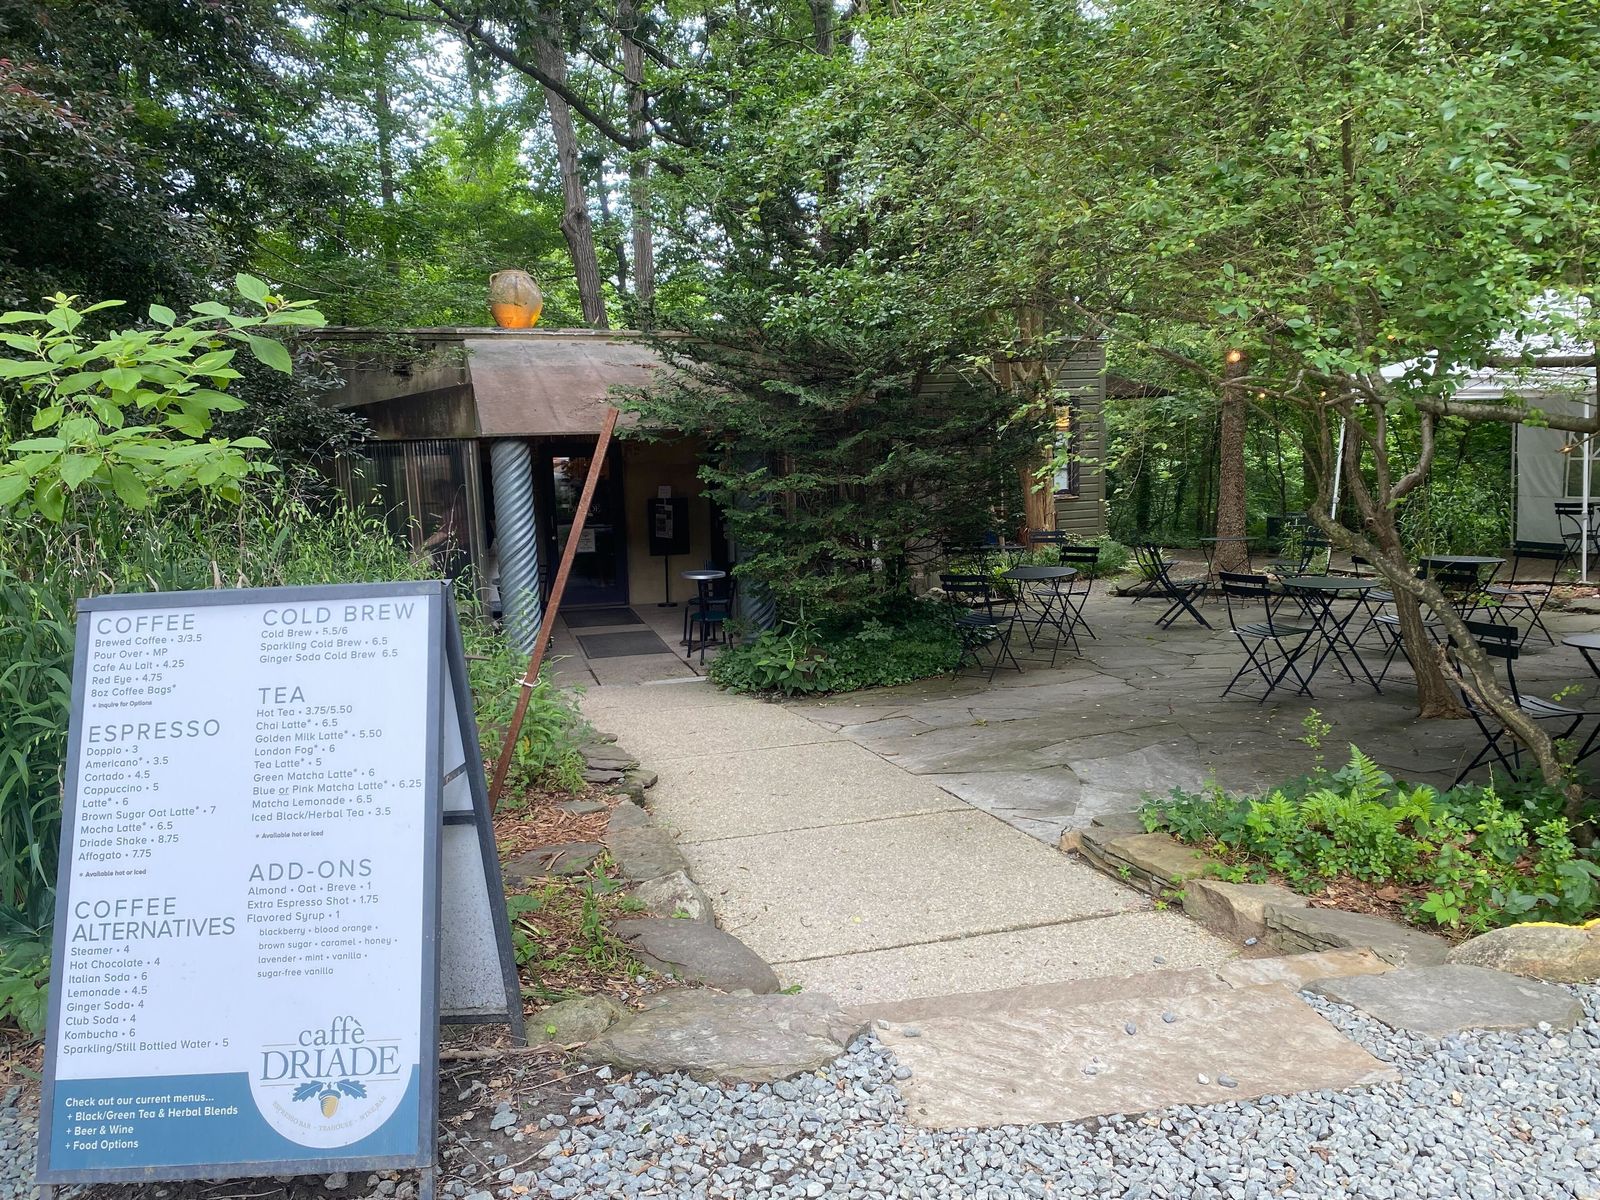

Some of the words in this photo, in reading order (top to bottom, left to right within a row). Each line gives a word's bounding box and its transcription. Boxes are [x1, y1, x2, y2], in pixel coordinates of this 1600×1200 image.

[262, 606, 331, 626] COLD
[344, 602, 414, 622] BREW
[97, 613, 195, 634] COFFEE
[261, 629, 284, 638] Cold
[287, 628, 312, 637] Brew
[322, 626, 348, 635] 5.5/6
[94, 637, 131, 647] Brewed
[134, 636, 166, 645] Coffee
[177, 633, 202, 642] 3/3.5
[260, 641, 307, 652] Sparkling
[310, 639, 333, 648] Cold
[336, 638, 361, 647] Brew
[371, 636, 387, 645] 6.5
[93, 651, 116, 659] Pour
[119, 650, 142, 658] Over
[153, 647, 168, 656] MP
[259, 655, 292, 664] Ginger
[295, 653, 320, 661] Soda
[324, 651, 347, 660] Cold
[350, 650, 375, 658] Brew
[382, 648, 398, 657] 6.5
[92, 663, 115, 672] Cafe
[118, 662, 131, 670] Au
[134, 661, 152, 670] Lait
[162, 659, 184, 668] 4.25
[91, 675, 110, 684] Red
[113, 675, 132, 685] Eye
[142, 672, 162, 682] 4.75
[90, 688, 108, 697] 8oz
[111, 686, 144, 696] Coffee
[258, 685, 305, 704] TEA
[256, 709, 274, 717] Hot
[277, 707, 294, 716] Tea
[305, 704, 352, 715] 3.75/5.50
[255, 721, 278, 730] Chai
[321, 718, 337, 727] 6.5
[88, 719, 220, 743] ESPRESSO
[255, 734, 291, 743] Golden
[294, 732, 315, 741] Milk
[359, 728, 382, 738] 5.50
[254, 746, 291, 756] London
[153, 756, 168, 765] 3.5
[253, 760, 271, 769] Tea
[84, 771, 124, 782] Cortado
[134, 769, 150, 779] 4.5
[253, 773, 283, 782] Green
[287, 771, 324, 780] Matcha
[83, 784, 142, 796] Cappuccino
[252, 786, 275, 795] Blue
[278, 787, 289, 795] or
[292, 784, 313, 793] Pink
[317, 782, 354, 792] Matcha
[399, 778, 421, 788] 6.25
[252, 798, 289, 808] Matcha
[292, 796, 345, 806] Lemonade
[356, 794, 372, 803] 6.5
[81, 812, 112, 821] Brown
[116, 810, 145, 820] Sugar
[148, 808, 166, 817] Oat
[251, 812, 272, 821] Iced
[276, 809, 343, 820] Black/Herbal
[346, 808, 364, 817] Tea
[375, 806, 391, 816] 3.5
[80, 824, 113, 834] Mocha
[157, 821, 173, 830] 6.5
[79, 837, 112, 847] Driade
[116, 836, 147, 845] Shake
[157, 833, 179, 843] 8.75
[78, 851, 121, 861] Affogato
[132, 848, 151, 858] 7.75
[248, 858, 371, 882] ADD-ONS
[247, 885, 286, 895] Almond
[297, 884, 316, 893] Oat
[327, 882, 356, 891] Breve
[74, 896, 176, 919] COFFEE
[247, 900, 273, 909] Extra
[277, 898, 322, 909] Espresso
[326, 896, 348, 905] Shot
[359, 894, 378, 903] 1.75
[246, 912, 291, 922] Flavored
[295, 911, 324, 922] Syrup
[71, 916, 235, 942] ALTERNATIVES
[259, 927, 305, 936] blackberry
[314, 925, 339, 933] blood
[341, 925, 372, 933] orange
[287, 941, 312, 949] sugar
[320, 938, 356, 947] caramel
[364, 937, 391, 945] honey
[70, 947, 113, 956] Steamer
[258, 954, 296, 963] lavender
[305, 953, 323, 961] mint
[332, 951, 361, 960] vanilla
[69, 960, 87, 969] Hot
[90, 959, 143, 968] Chocolate
[68, 974, 100, 984] Italian
[104, 972, 129, 982] Soda
[257, 968, 301, 979] sugar-free
[304, 966, 333, 975] vanilla
[67, 986, 120, 997] Lemonade
[131, 985, 147, 994] 4.5
[66, 1002, 101, 1013] Ginger
[103, 1000, 130, 1010] Soda
[65, 1016, 89, 1026] Club
[92, 1015, 118, 1024] Soda
[64, 1029, 117, 1040] Kombucha
[299, 1015, 365, 1047] caffè
[63, 1042, 136, 1055] Sparkling/Still
[139, 1040, 176, 1050] Bottled
[180, 1039, 211, 1048] Water
[260, 1045, 401, 1080] DRIADE
[65, 1097, 95, 1107] Check
[98, 1097, 114, 1105] out
[135, 1094, 170, 1104] current
[173, 1094, 214, 1102] menus...
[75, 1110, 135, 1121] Black/Green
[138, 1109, 155, 1118] Tea
[167, 1106, 201, 1117] Herbal
[204, 1105, 237, 1115] Blends
[74, 1126, 97, 1135] Beer
[109, 1124, 133, 1134] Wine
[73, 1140, 97, 1150] Food
[100, 1139, 138, 1151] Options
